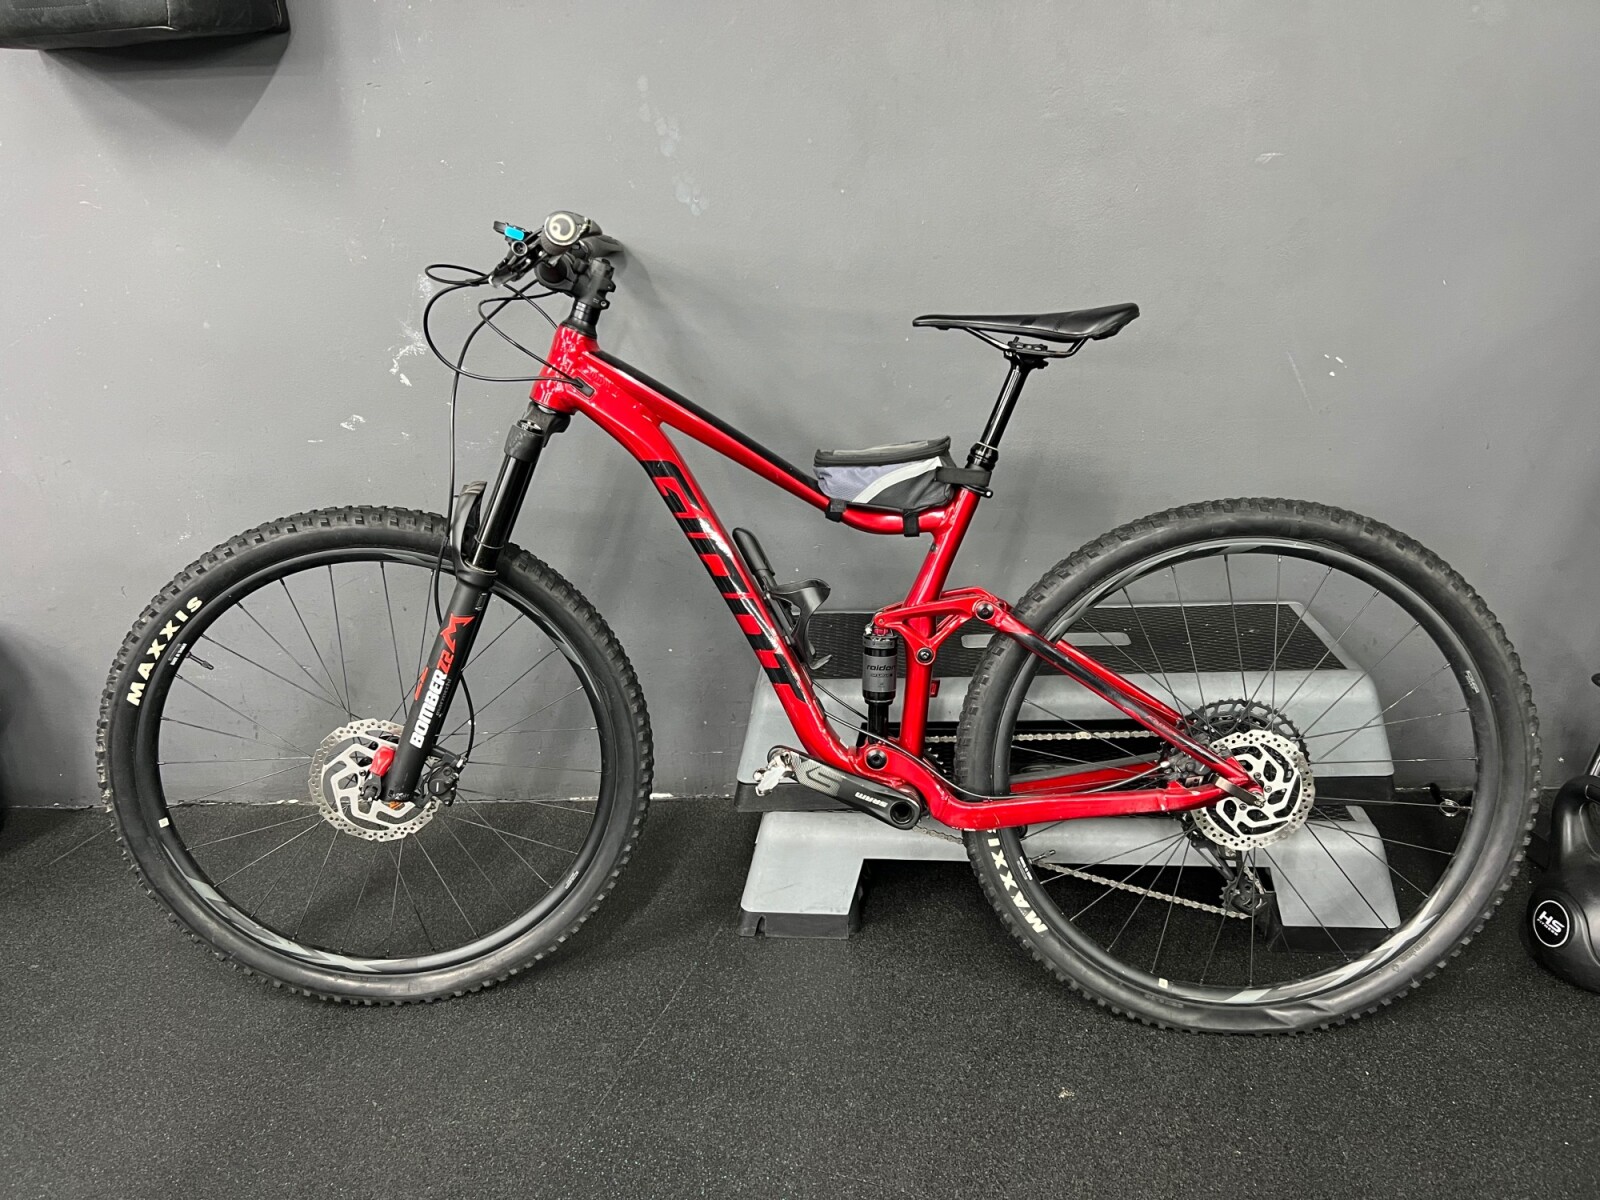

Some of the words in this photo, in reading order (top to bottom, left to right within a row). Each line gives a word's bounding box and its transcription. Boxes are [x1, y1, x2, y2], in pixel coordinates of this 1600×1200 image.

[126, 596, 203, 706] MAXXIS
[410, 668, 448, 749] BOMBER
[854, 791, 889, 808] SRAM
[986, 829, 1049, 933] MAXXI
[1538, 911, 1565, 933] HS
